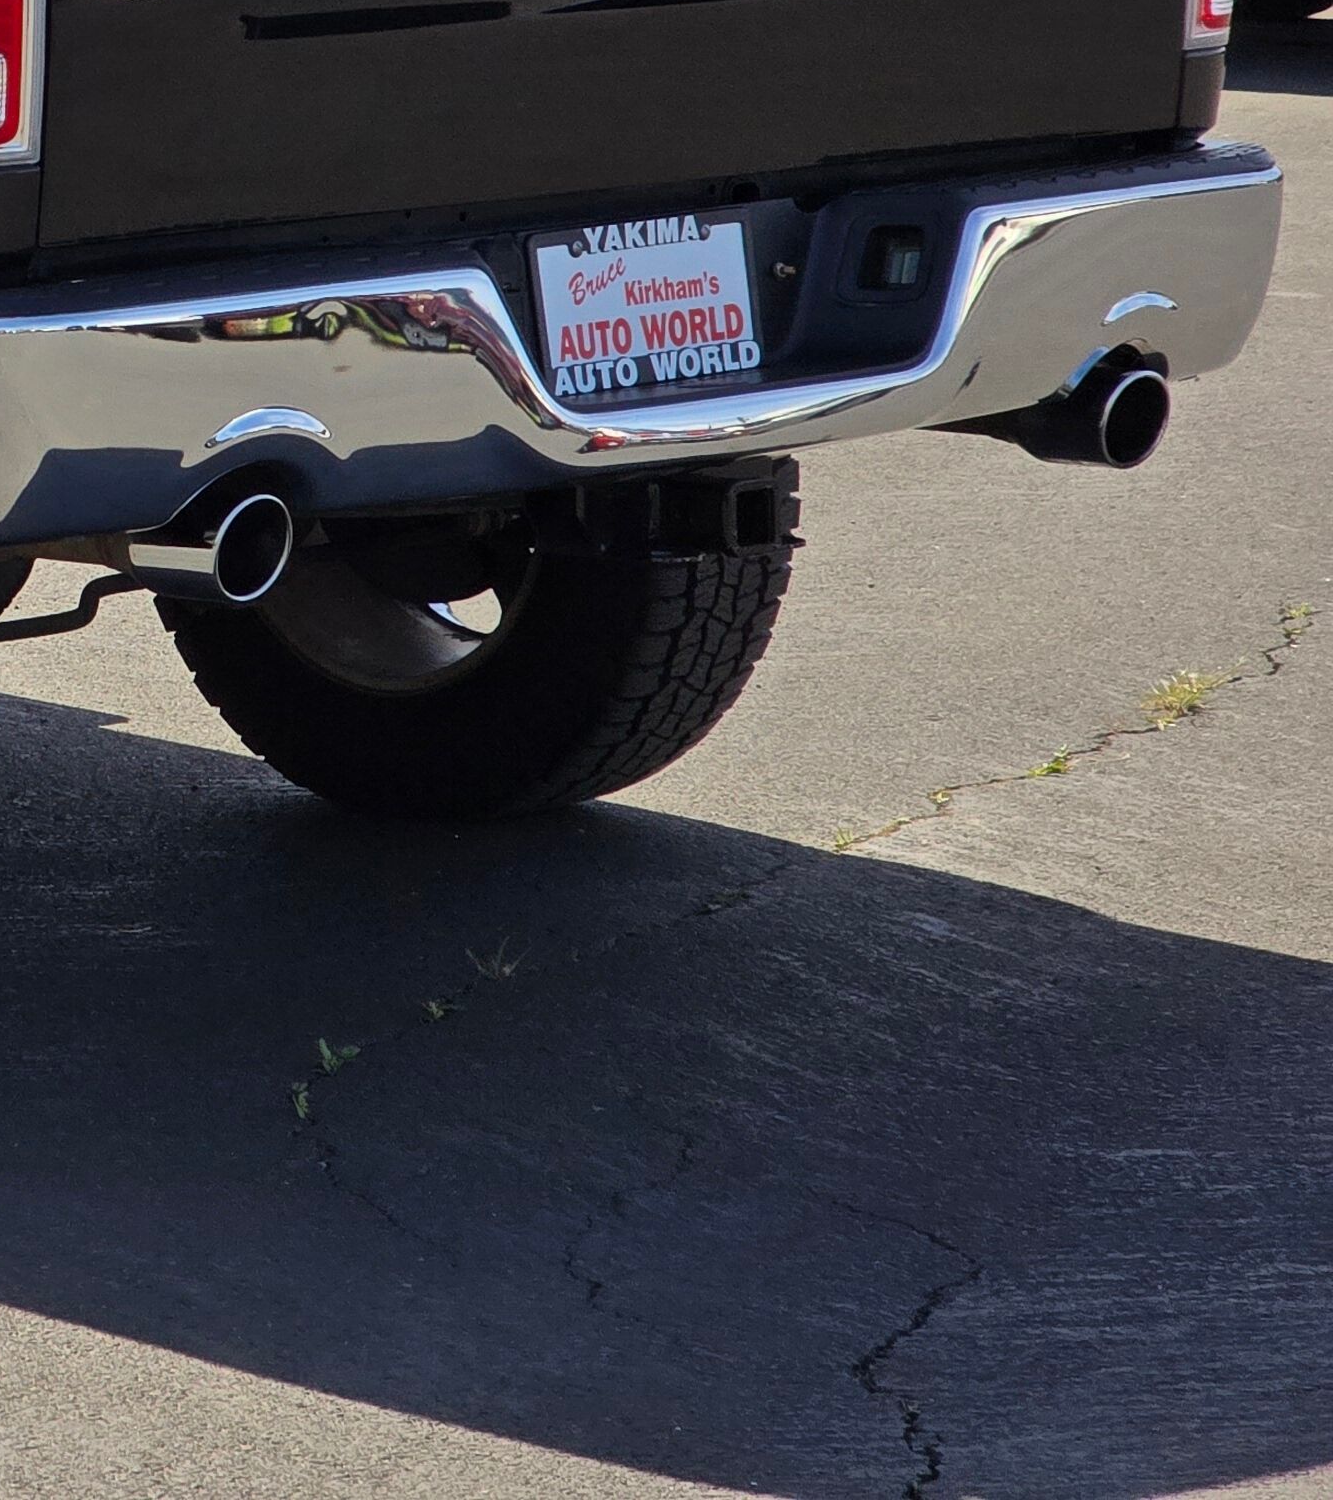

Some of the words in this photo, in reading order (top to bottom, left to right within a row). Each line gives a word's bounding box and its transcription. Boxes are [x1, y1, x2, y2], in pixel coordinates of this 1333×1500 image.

[583, 215, 700, 255] YAKIMA
[568, 256, 627, 306] Bruce
[624, 271, 720, 307] Kirkham's
[560, 318, 632, 362] AUTO
[640, 303, 744, 350] WORLD
[555, 358, 638, 396] AUTO
[650, 341, 761, 382] WORLD
